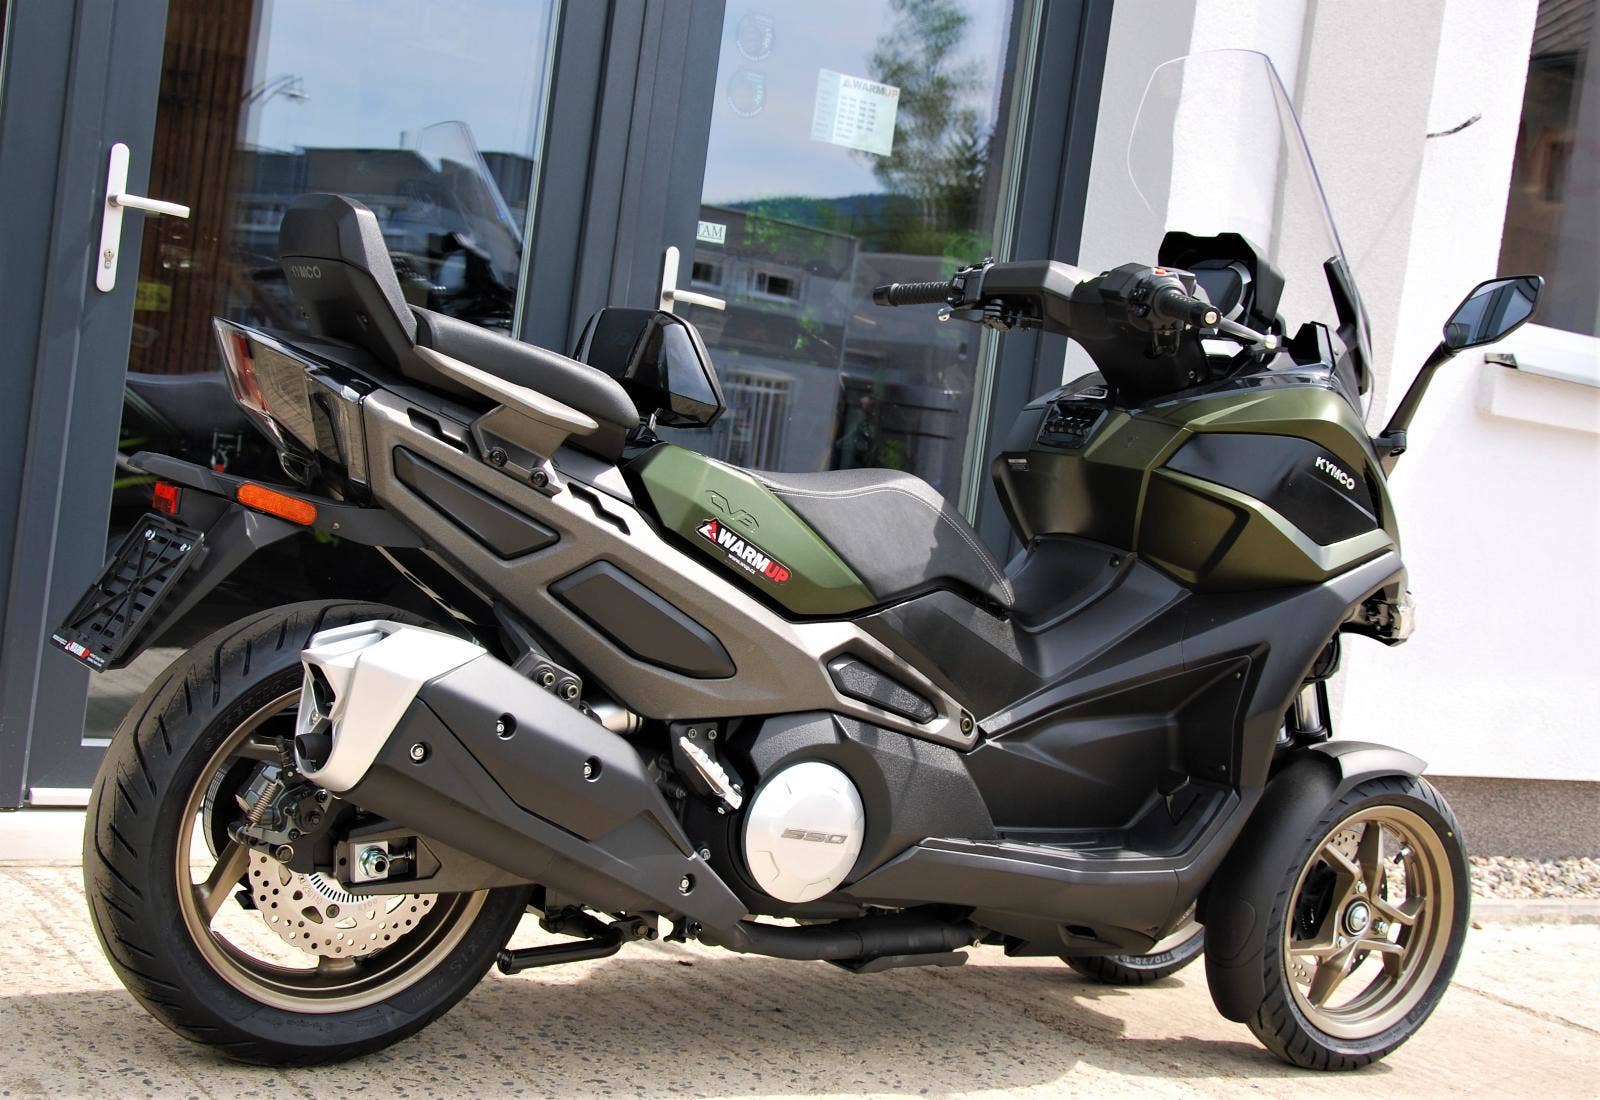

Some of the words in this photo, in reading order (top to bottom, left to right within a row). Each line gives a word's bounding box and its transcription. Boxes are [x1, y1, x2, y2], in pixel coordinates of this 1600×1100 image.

[1316, 457, 1355, 490] KYMCO
[717, 528, 789, 582] WARMUP
[781, 828, 848, 844] 550
